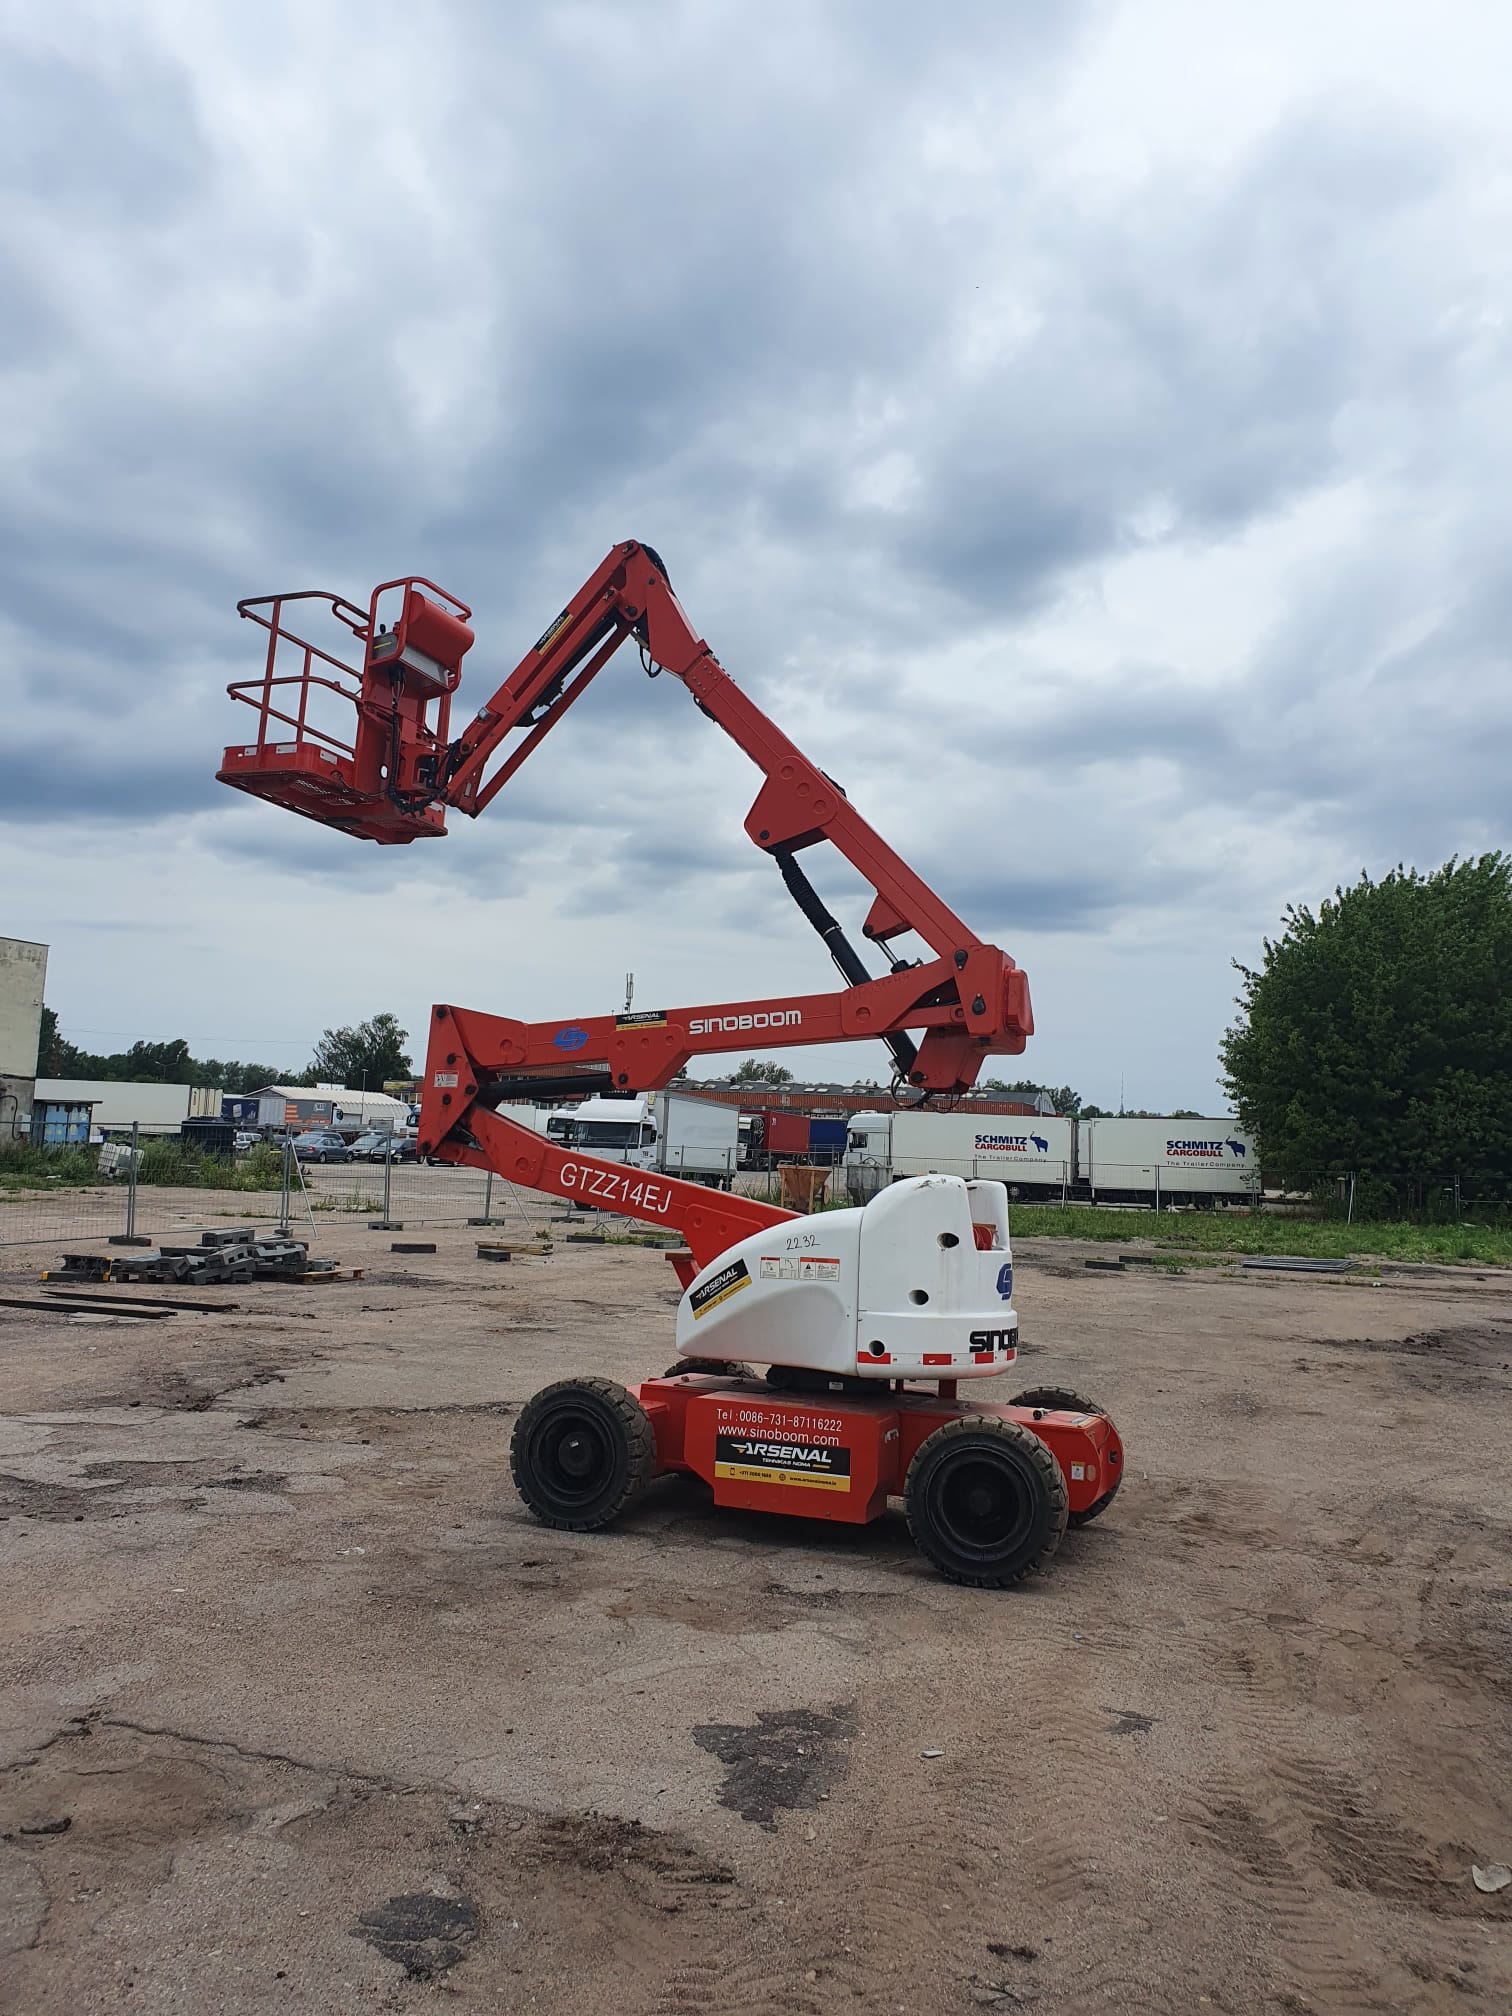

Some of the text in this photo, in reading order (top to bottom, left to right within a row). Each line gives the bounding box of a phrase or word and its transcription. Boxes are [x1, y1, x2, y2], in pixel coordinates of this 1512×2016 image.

[622, 1012, 660, 1021] ARSENAL
[689, 1010, 802, 1035] SINOBOOM
[975, 1134, 1028, 1145] SCHMITZ
[975, 1143, 1028, 1152] CARGOBULL
[1166, 1140, 1223, 1150] SCHMITZ
[1166, 1149, 1224, 1157] CARGOBULL
[560, 1162, 673, 1213] GTZZ14EJ
[696, 1268, 738, 1299] ARSENAL
[969, 1328, 1018, 1352] SINOB
[718, 1425, 839, 1446] www.sinoboom.com
[731, 1442, 832, 1463] ARSENAL
[792, 1460, 811, 1468] NOMA
